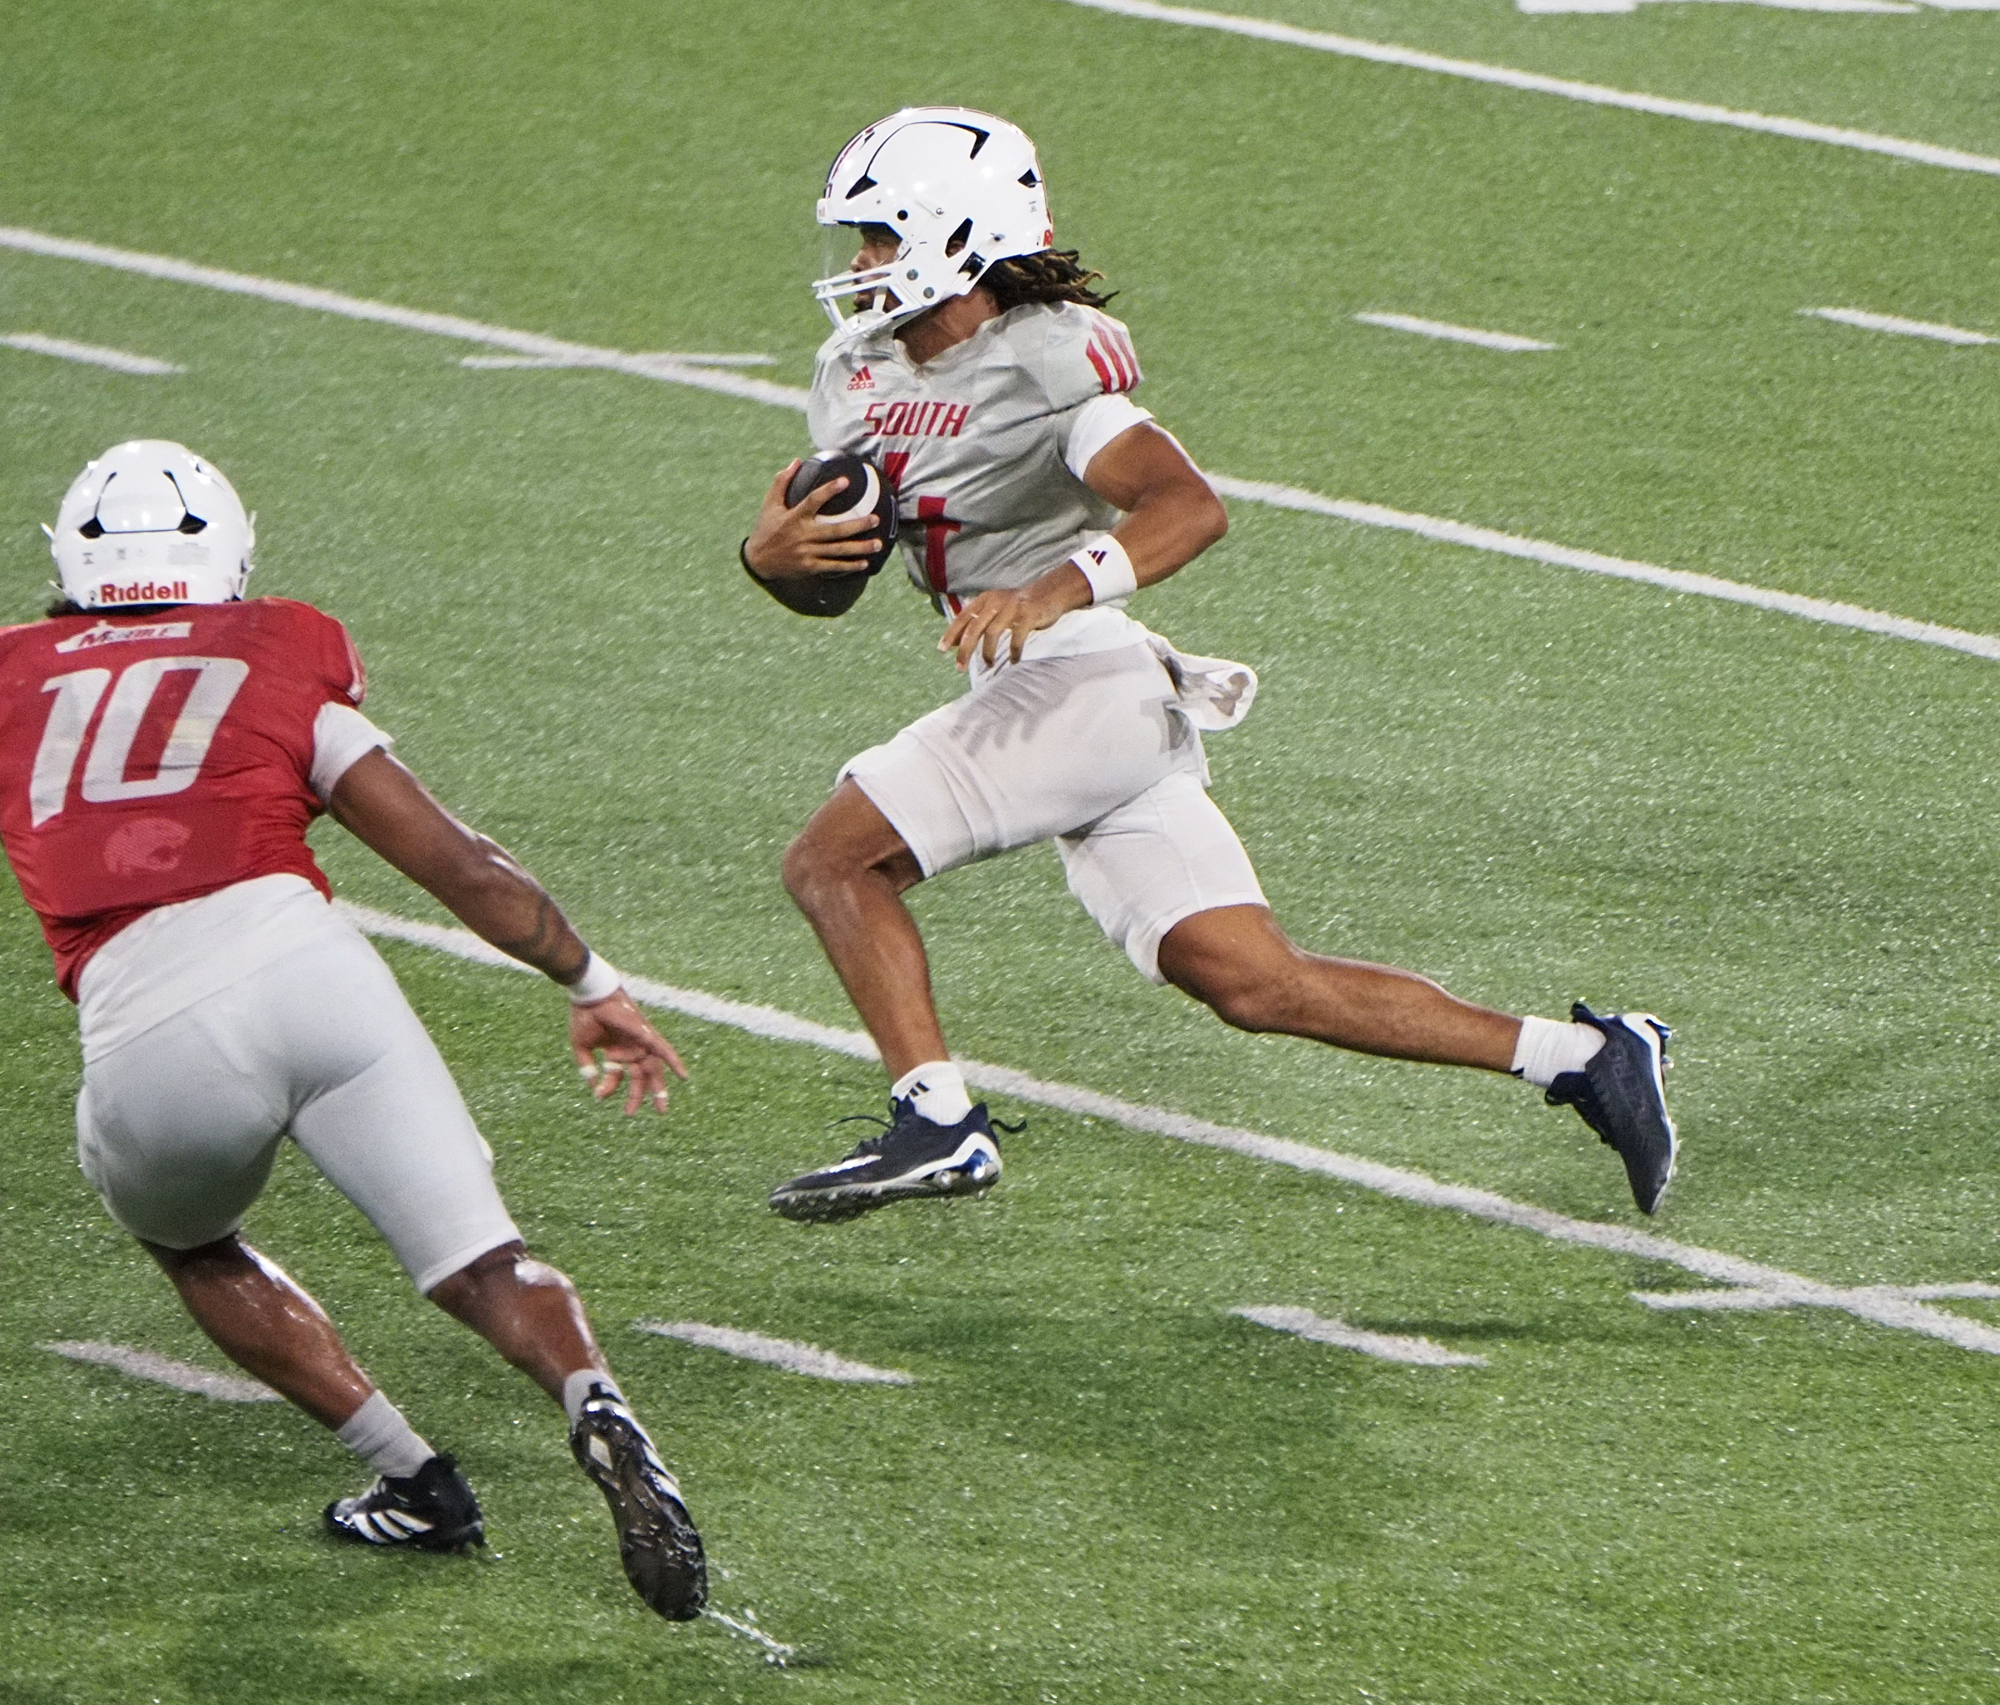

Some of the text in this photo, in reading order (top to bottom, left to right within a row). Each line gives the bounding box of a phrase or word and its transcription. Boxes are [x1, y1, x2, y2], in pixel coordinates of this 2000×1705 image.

[847, 382, 875, 391] adidas
[861, 401, 971, 437] SOUTH
[101, 581, 188, 603] Riddell
[29, 656, 249, 828] 10
